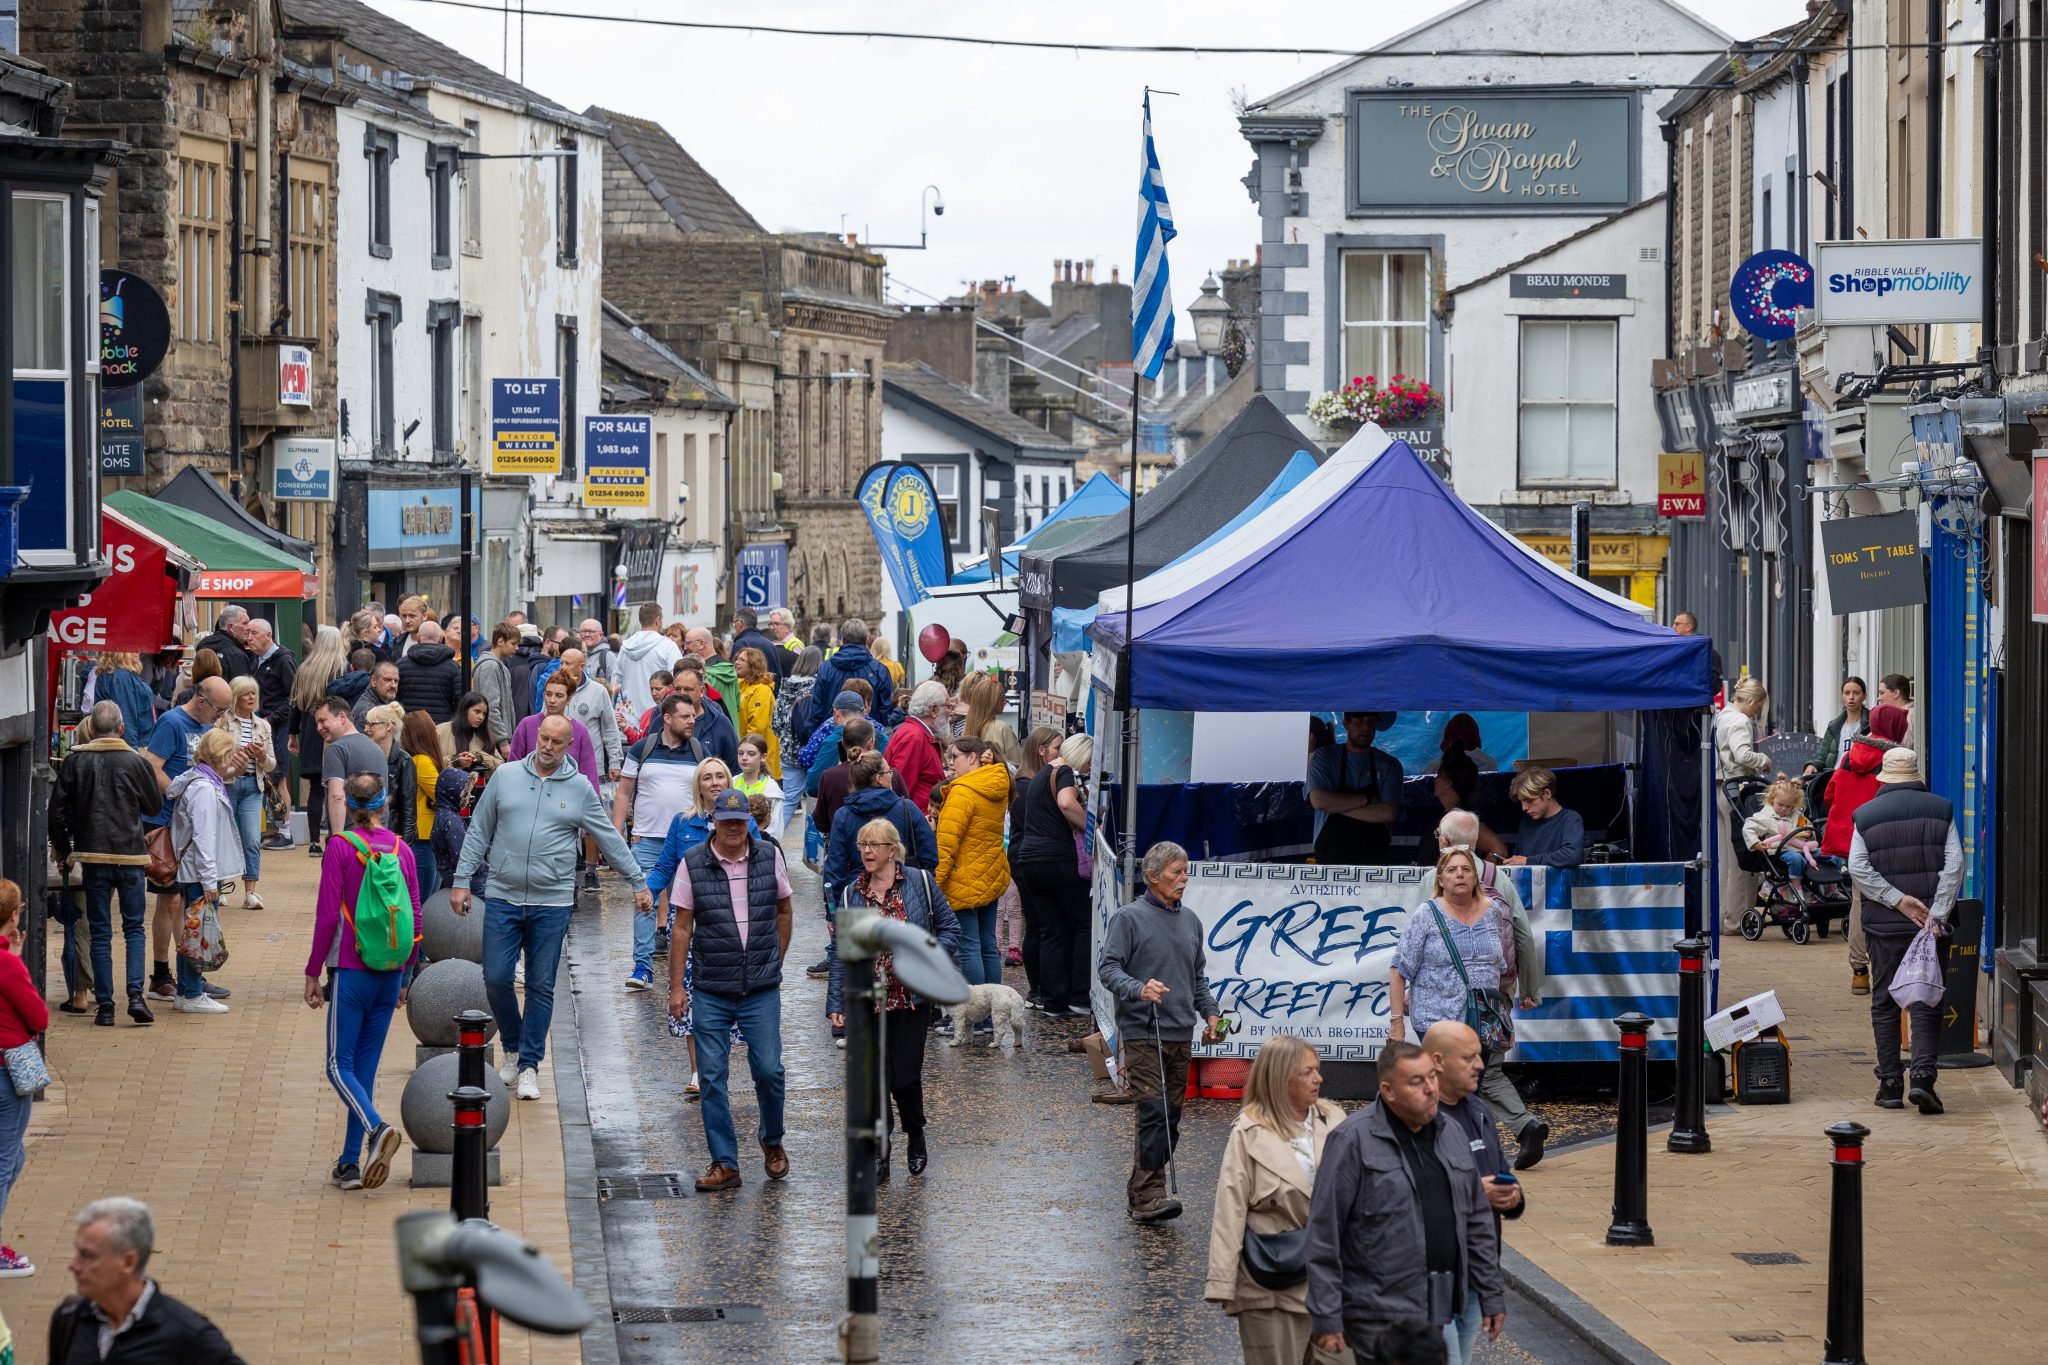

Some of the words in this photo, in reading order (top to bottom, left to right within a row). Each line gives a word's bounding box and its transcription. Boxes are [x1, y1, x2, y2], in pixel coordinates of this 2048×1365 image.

[1400, 106, 1432, 117] THE
[1428, 106, 1536, 155] Swan
[1430, 155, 1456, 177] &
[1456, 141, 1581, 193] Royal
[1521, 184, 1580, 196] HOTEL
[1854, 268, 1890, 277] RIBBLE
[1891, 267, 1927, 276] VALLEY
[1527, 275, 1561, 286] BEAU
[1563, 275, 1610, 286] MONDE
[1829, 272, 1972, 297] Shopmobility
[101, 344, 139, 360] ubble
[101, 360, 138, 375] nack
[504, 384, 521, 394] TO
[525, 384, 547, 394] LET
[589, 421, 614, 433] FOR
[616, 421, 647, 433] SALE
[102, 444, 130, 455] UITE
[596, 445, 619, 455] 1,983
[620, 445, 639, 455] sq.ft
[103, 457, 131, 468] OMS
[278, 482, 328, 490] CONSERVATIVE
[1662, 498, 1701, 511] EWM
[1591, 544, 1630, 555] EWS
[1830, 551, 1859, 565] TOMS
[1861, 545, 1882, 562] T
[1886, 543, 1915, 558] TABLE
[102, 544, 135, 573] NS
[747, 566, 766, 575] WH
[213, 578, 254, 591] SHOP
[745, 574, 766, 605] S
[48, 616, 107, 645] AGE
[1208, 900, 1405, 975] GREE
[1960, 945, 1978, 956] TABLE
[1920, 955, 1936, 963] BAK
[1206, 977, 1349, 1019] TREET
[1345, 981, 1392, 1019] FO
